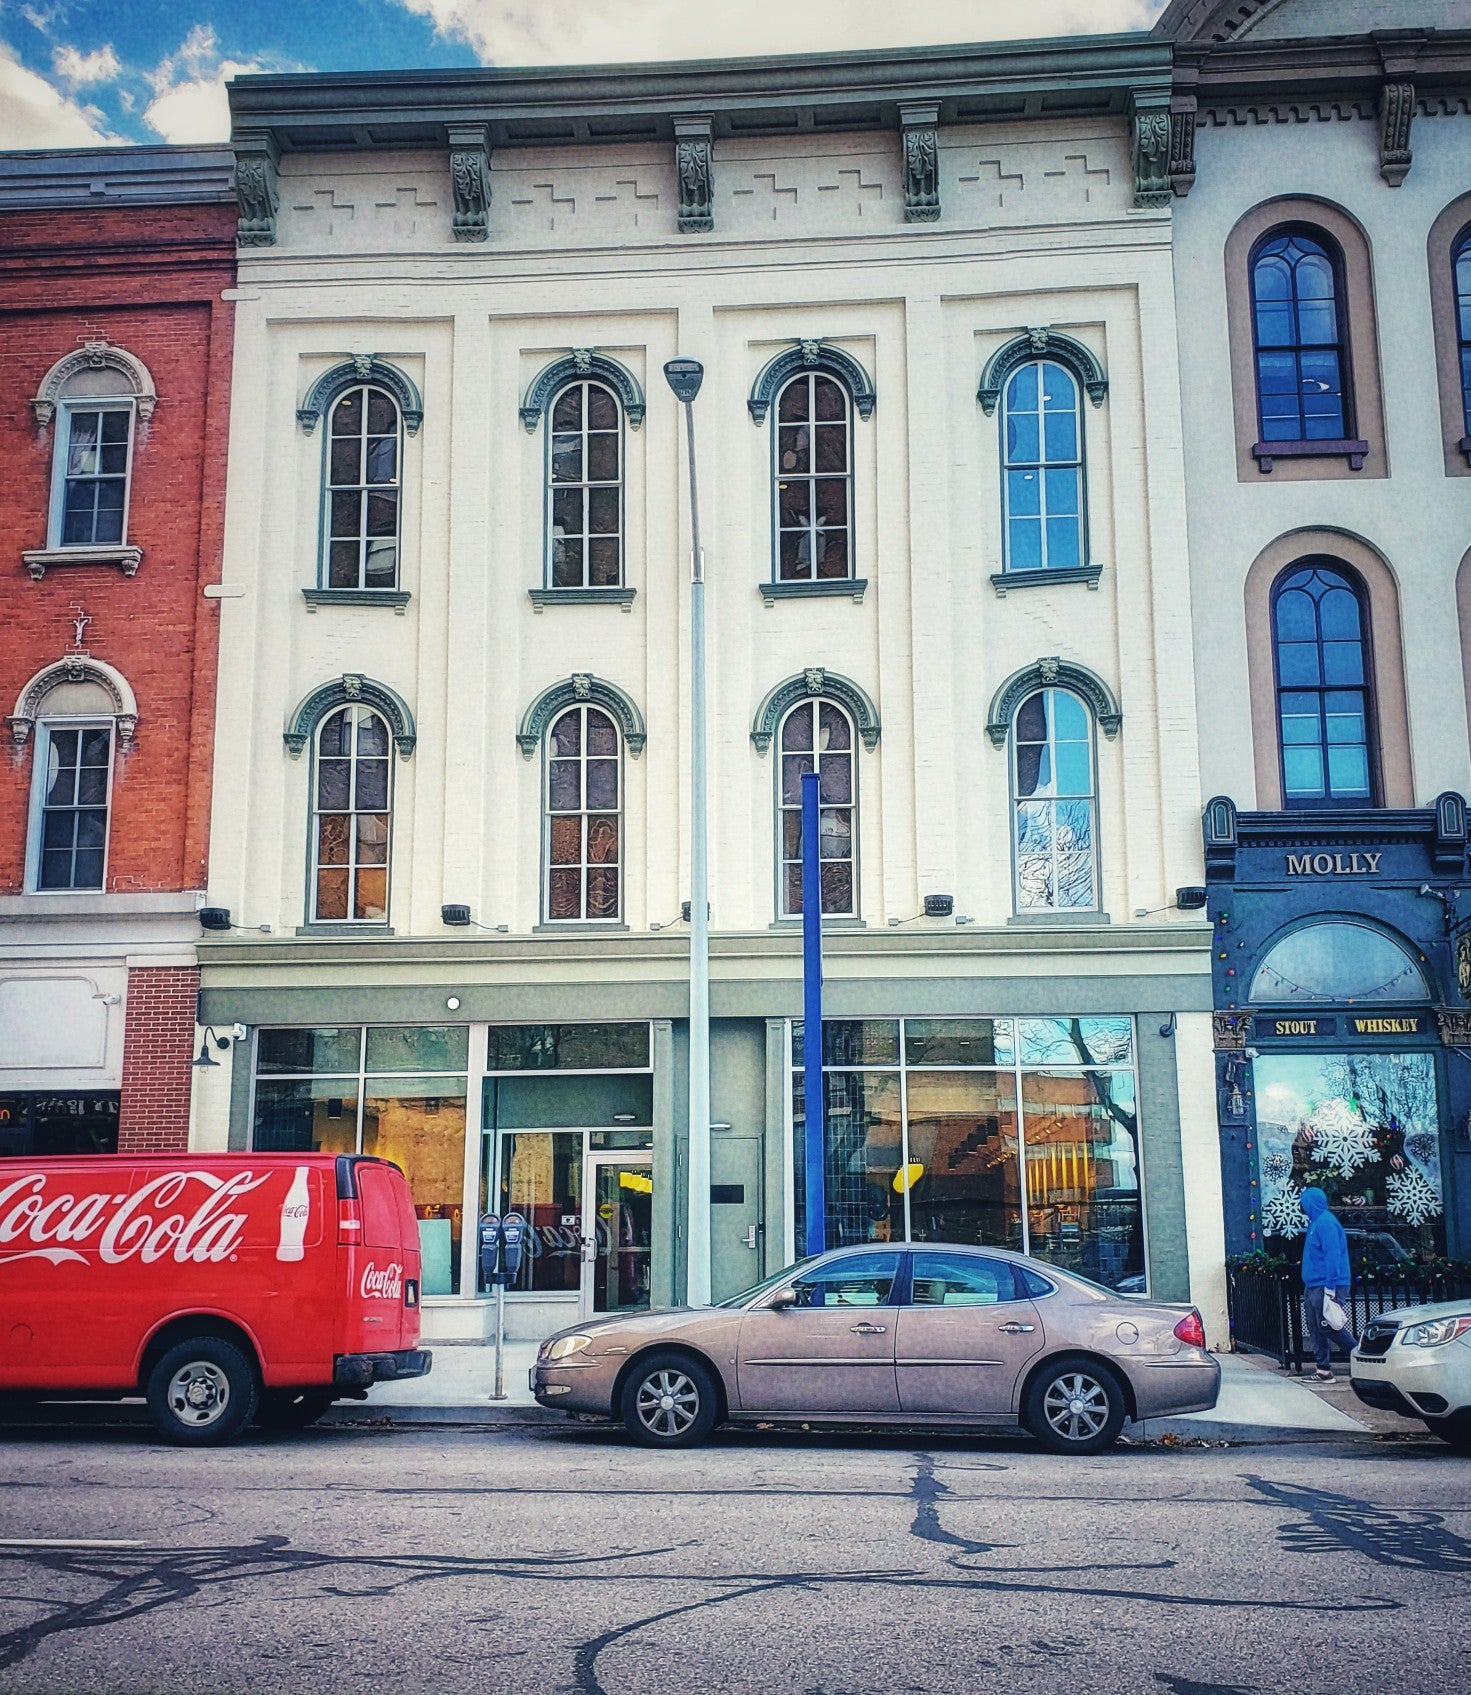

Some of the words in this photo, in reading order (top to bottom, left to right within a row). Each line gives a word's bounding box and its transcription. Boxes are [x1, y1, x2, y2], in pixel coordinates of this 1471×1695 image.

[1286, 853, 1382, 875] MOLLY
[1275, 1020, 1317, 1035] STOUT
[1355, 1018, 1418, 1033] WHISKEY
[360, 1261, 403, 1299] Coca-Cola
